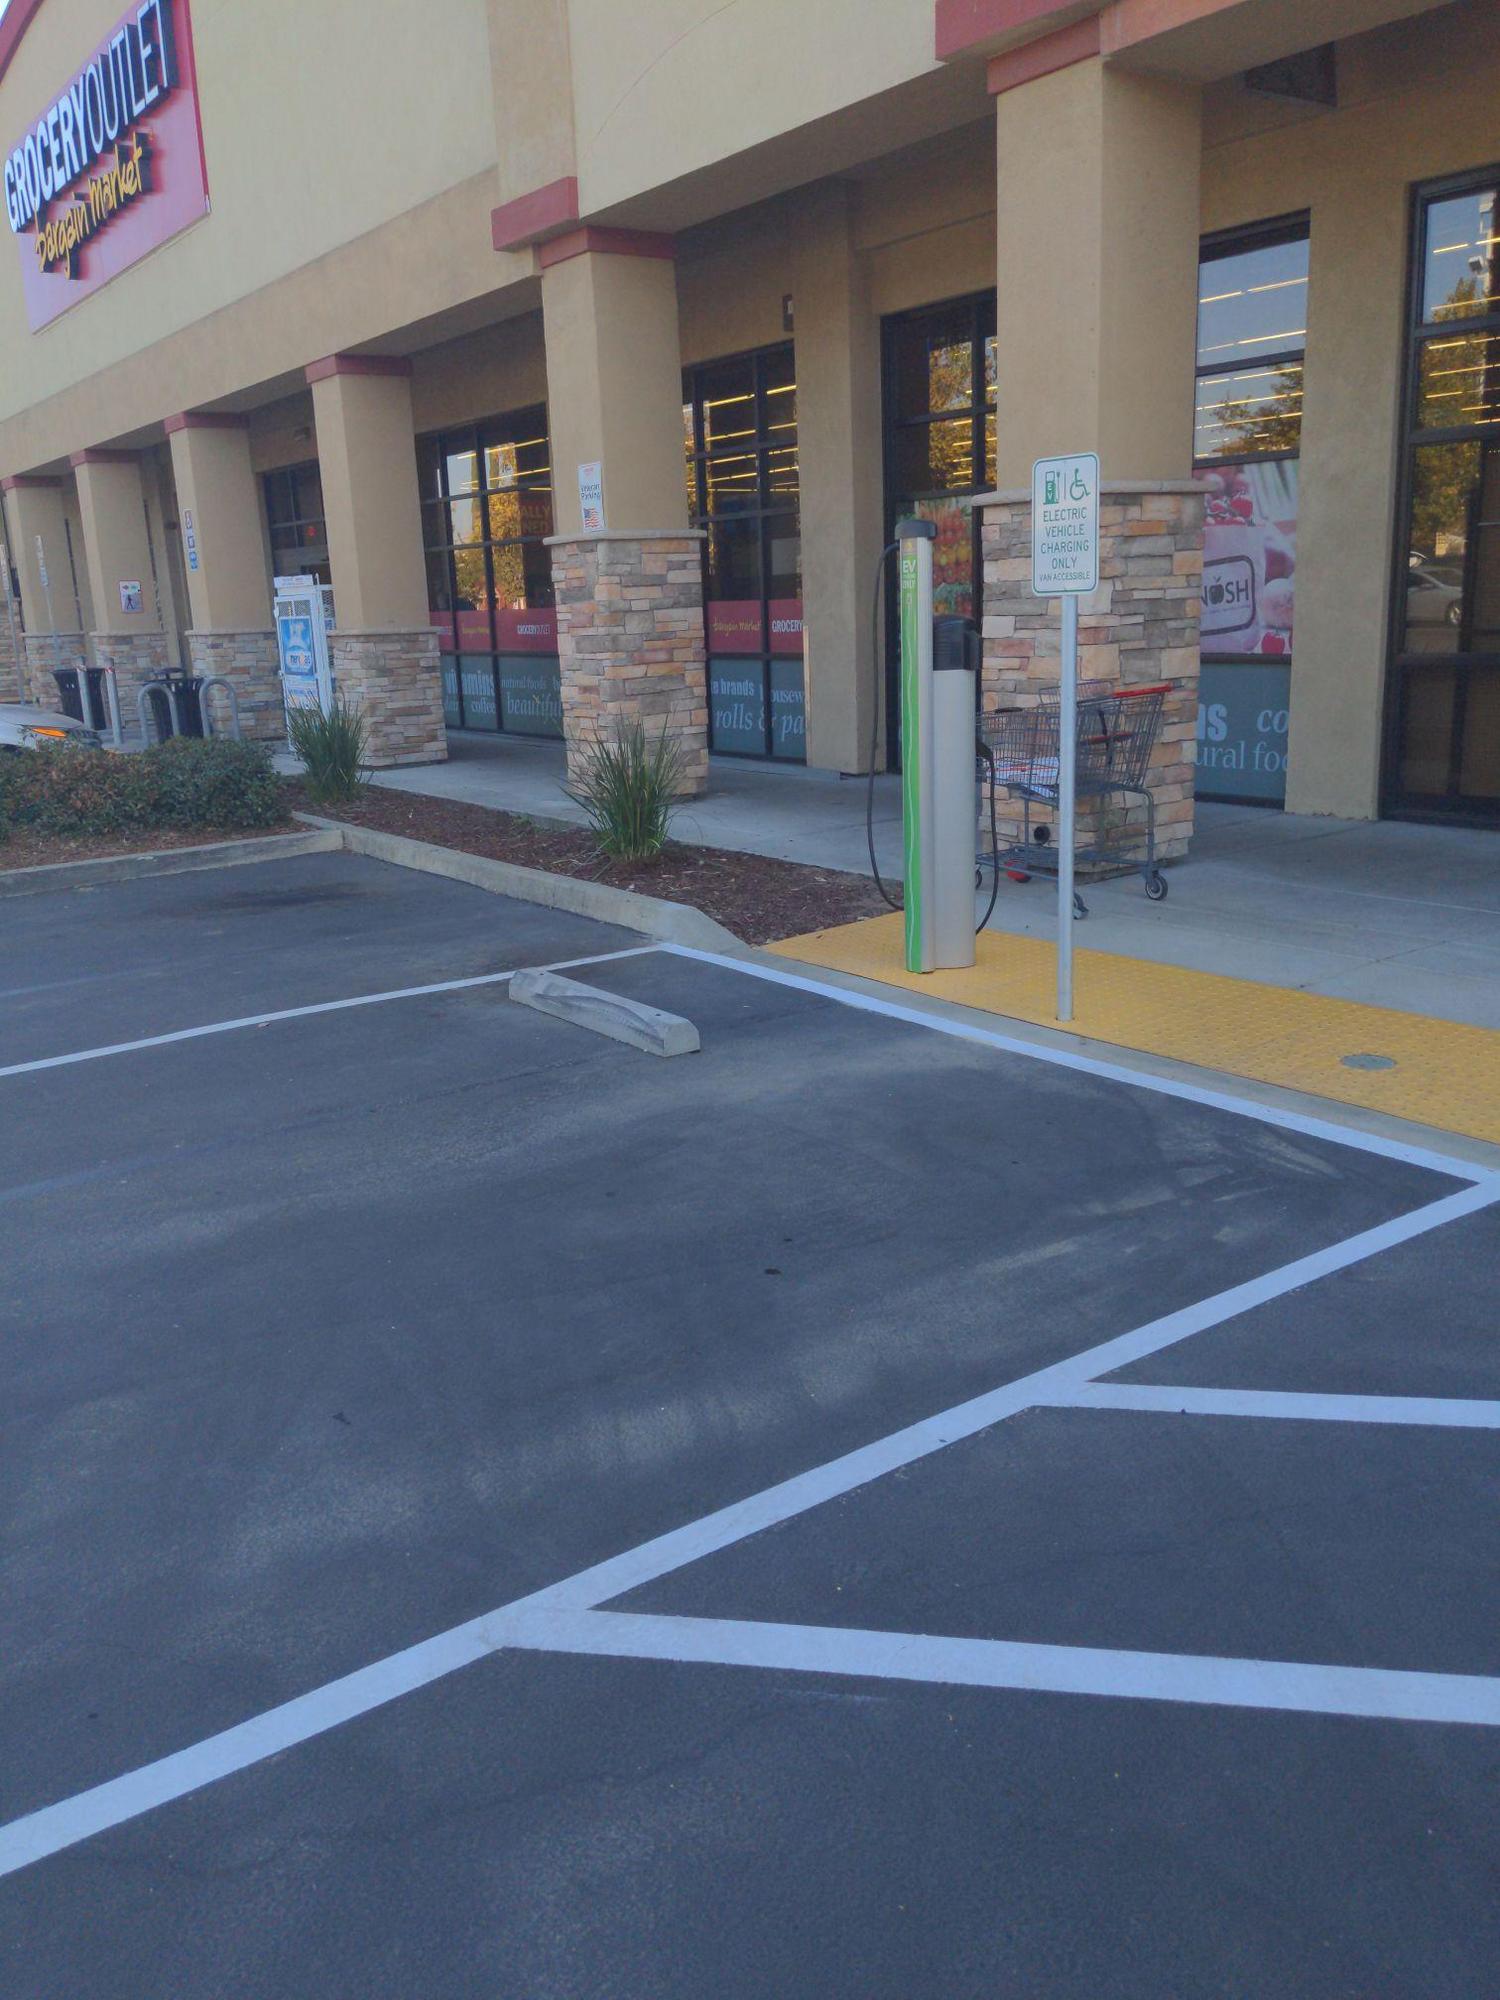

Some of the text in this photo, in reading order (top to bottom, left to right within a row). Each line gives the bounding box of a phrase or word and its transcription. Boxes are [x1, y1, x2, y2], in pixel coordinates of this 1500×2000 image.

[34, 193, 90, 280] bargain
[1043, 507, 1087, 522] ELECTRIC
[1045, 524, 1085, 537] VEHICLE
[1041, 540, 1089, 554] CHARGING
[902, 560, 916, 573] EV
[1052, 557, 1077, 570] ONLY
[1039, 571, 1090, 582] VAN ACCESSIBLE
[445, 669, 496, 697] viamins
[720, 678, 754, 697] brands
[715, 703, 753, 730] rolls
[782, 714, 804, 742] pa
[1257, 709, 1289, 734] co
[1195, 741, 1245, 769] ural
